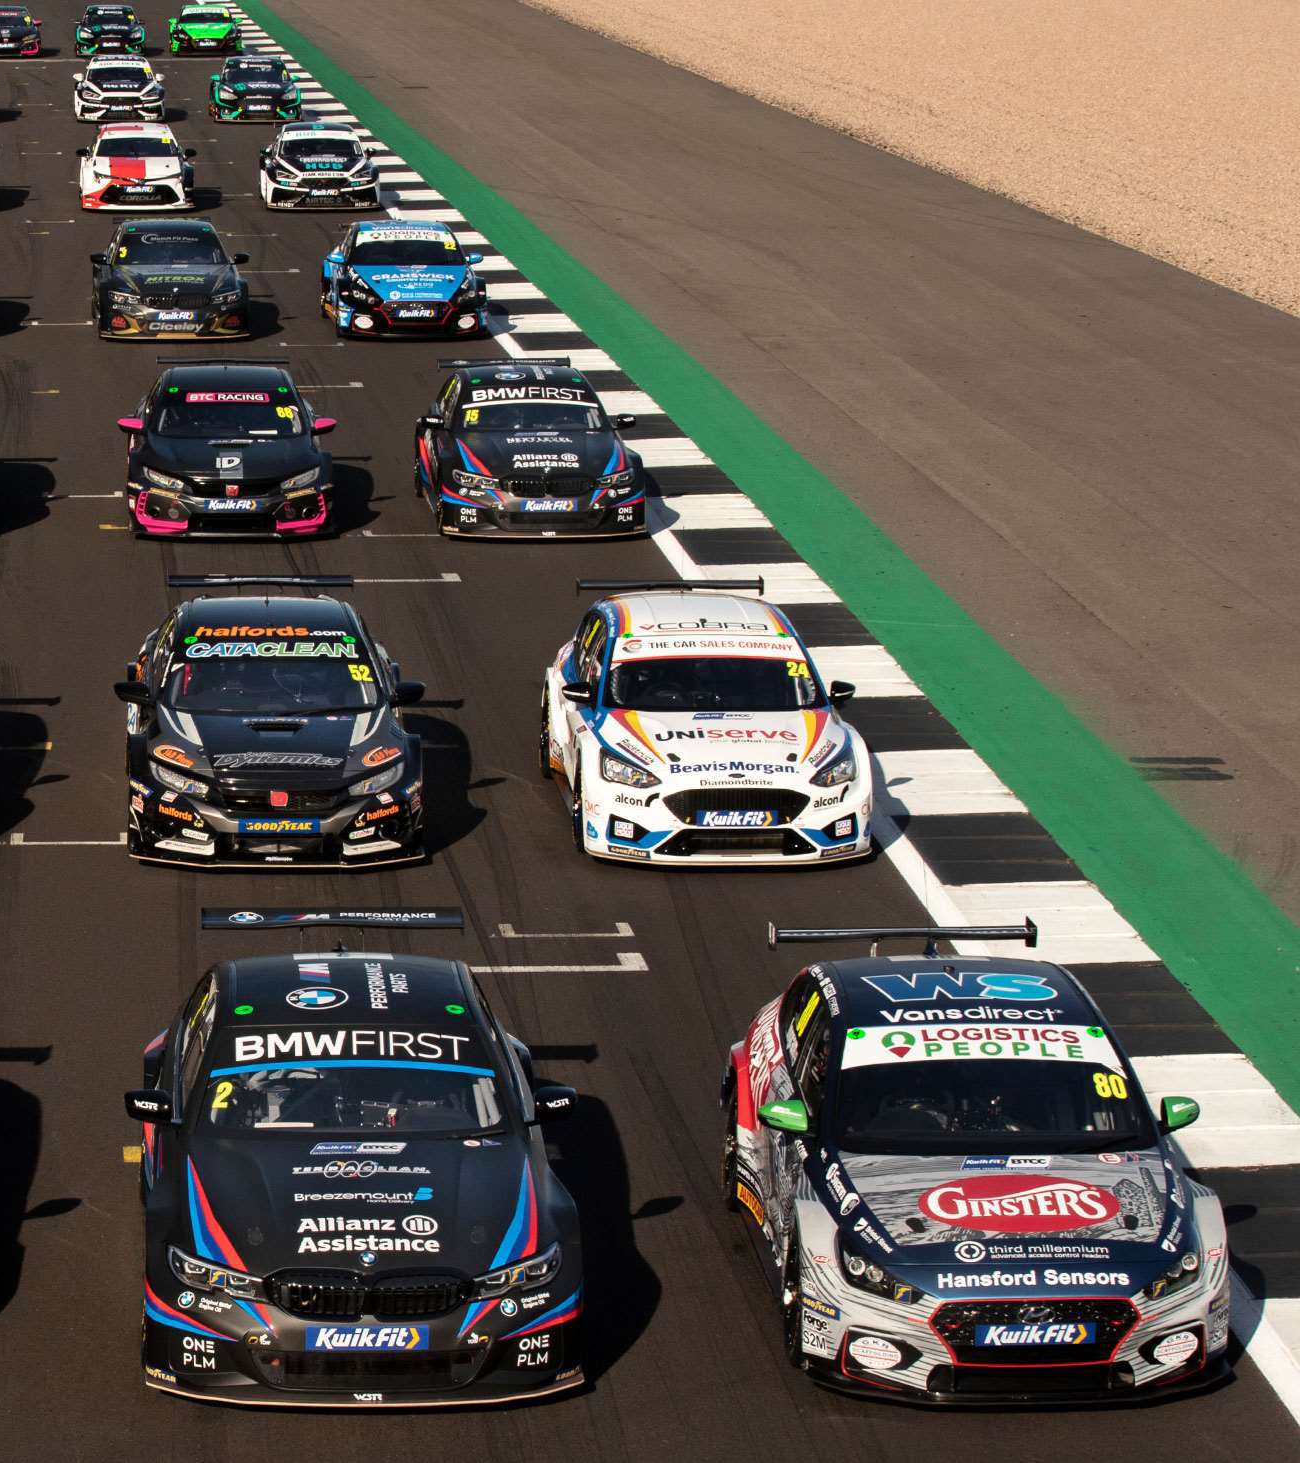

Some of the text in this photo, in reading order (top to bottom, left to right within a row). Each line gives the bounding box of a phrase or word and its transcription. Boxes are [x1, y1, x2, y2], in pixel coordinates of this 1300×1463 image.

[149, 322, 204, 332] Ciceley
[208, 500, 251, 510] KwikFit
[525, 501, 567, 511] KwikFit
[460, 515, 477, 523] PLM
[186, 642, 359, 658] CATACLEAN
[739, 641, 793, 651] COMPANY
[348, 664, 373, 682] 52
[787, 662, 809, 678] 24
[615, 794, 643, 806] alcon
[813, 795, 838, 808] alcon
[158, 804, 192, 821] halfords
[366, 805, 398, 820] halfords
[703, 811, 764, 826] KwikFit
[246, 820, 312, 832] GOODYEAR
[365, 963, 389, 1009] PERFORMANCE
[389, 973, 409, 993] PARTS
[861, 972, 1058, 1003] WS
[922, 1028, 1080, 1045] LOGISTICS
[925, 1040, 1085, 1058] PEOPLE
[1093, 1072, 1128, 1100] 80
[212, 1082, 233, 1109] 2
[294, 1192, 413, 1202] Breezemount
[297, 1217, 396, 1233] Allianz
[298, 1235, 440, 1253] Assistance
[1028, 1245, 1108, 1253] millennium
[937, 1269, 1130, 1289] Hansford Sensors
[804, 1310, 827, 1331] Forge
[316, 1327, 408, 1348] KwikFit
[519, 1334, 550, 1350] ONE
[803, 1331, 825, 1350] S2M
[984, 1325, 1075, 1343] KwikFit
[183, 1337, 215, 1354] ONE
[183, 1353, 215, 1369] PLM
[517, 1351, 548, 1366] PLM
